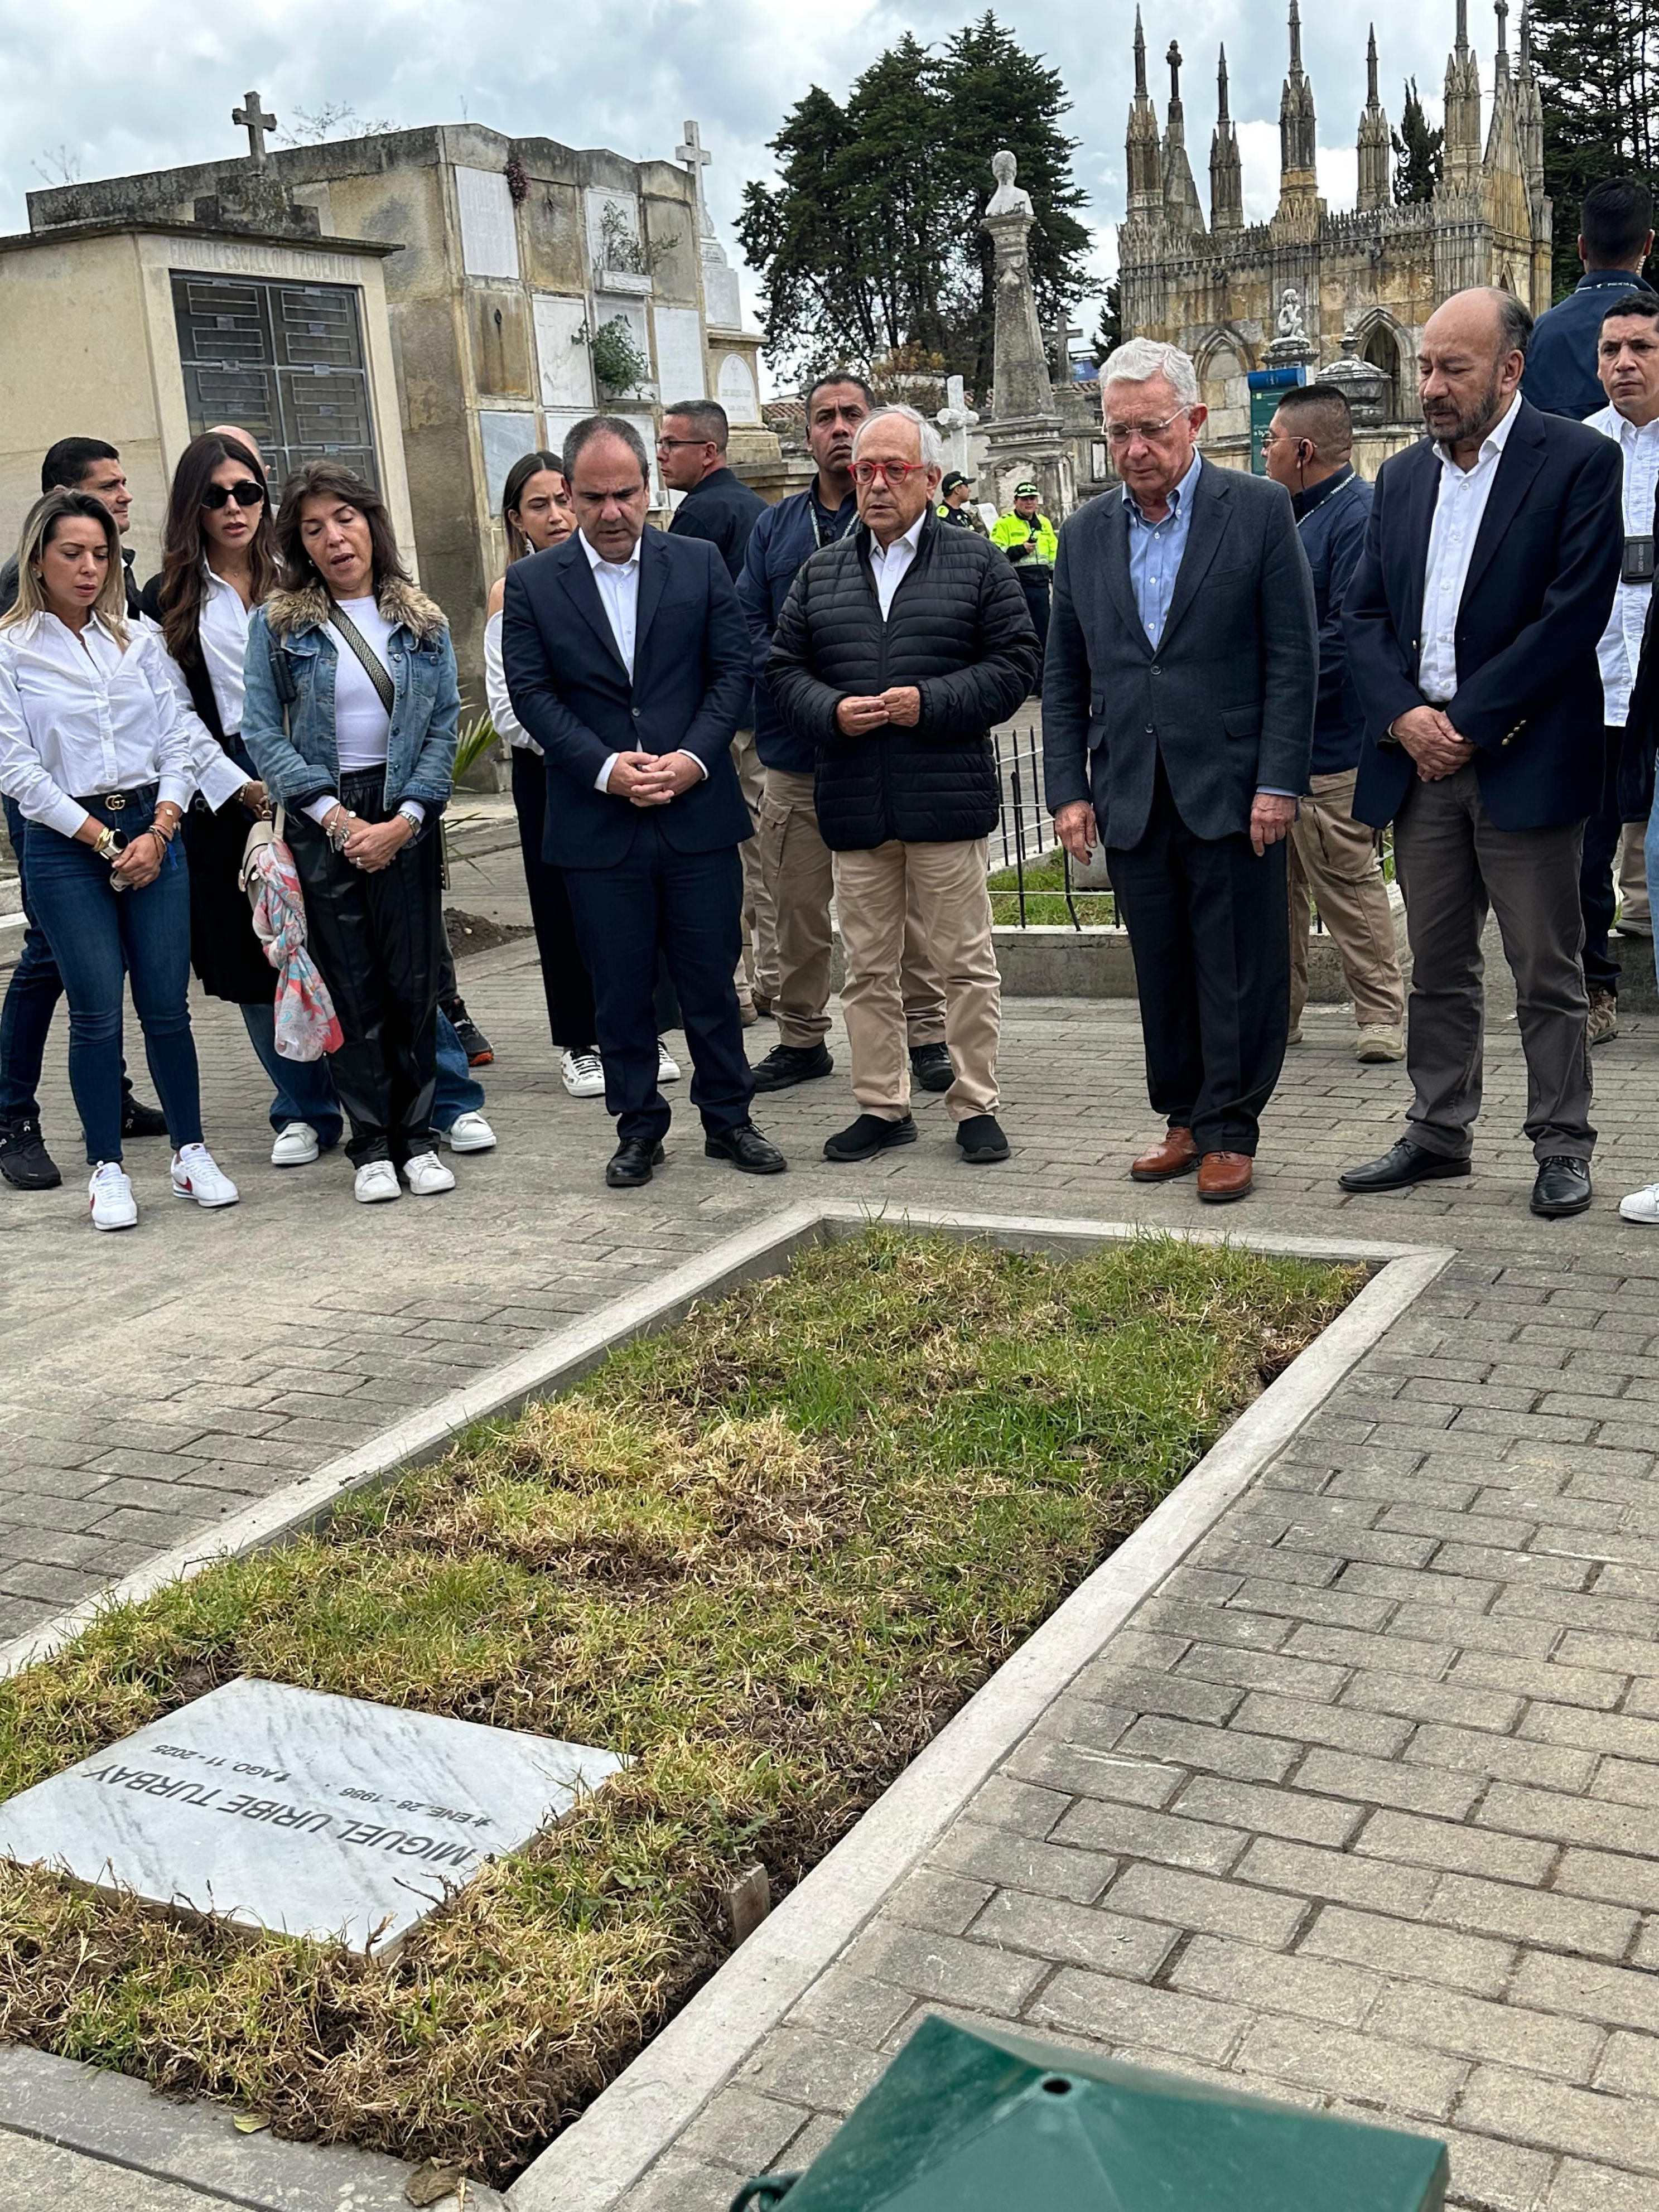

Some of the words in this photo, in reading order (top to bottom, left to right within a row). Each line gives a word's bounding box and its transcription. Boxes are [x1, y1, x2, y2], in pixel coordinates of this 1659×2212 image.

[169, 239, 222, 268] FAMILIA
[151, 1745, 198, 1760] 2025
[204, 1756, 227, 1766] 11
[232, 1761, 278, 1778] AGO.
[81, 1764, 222, 1807] TURBAY
[339, 1788, 384, 1803] 1986
[216, 1794, 332, 1833] URIBE
[397, 1800, 425, 1812] 28
[426, 1805, 474, 1823] ENE.
[336, 1819, 478, 1866] MIGUEL
